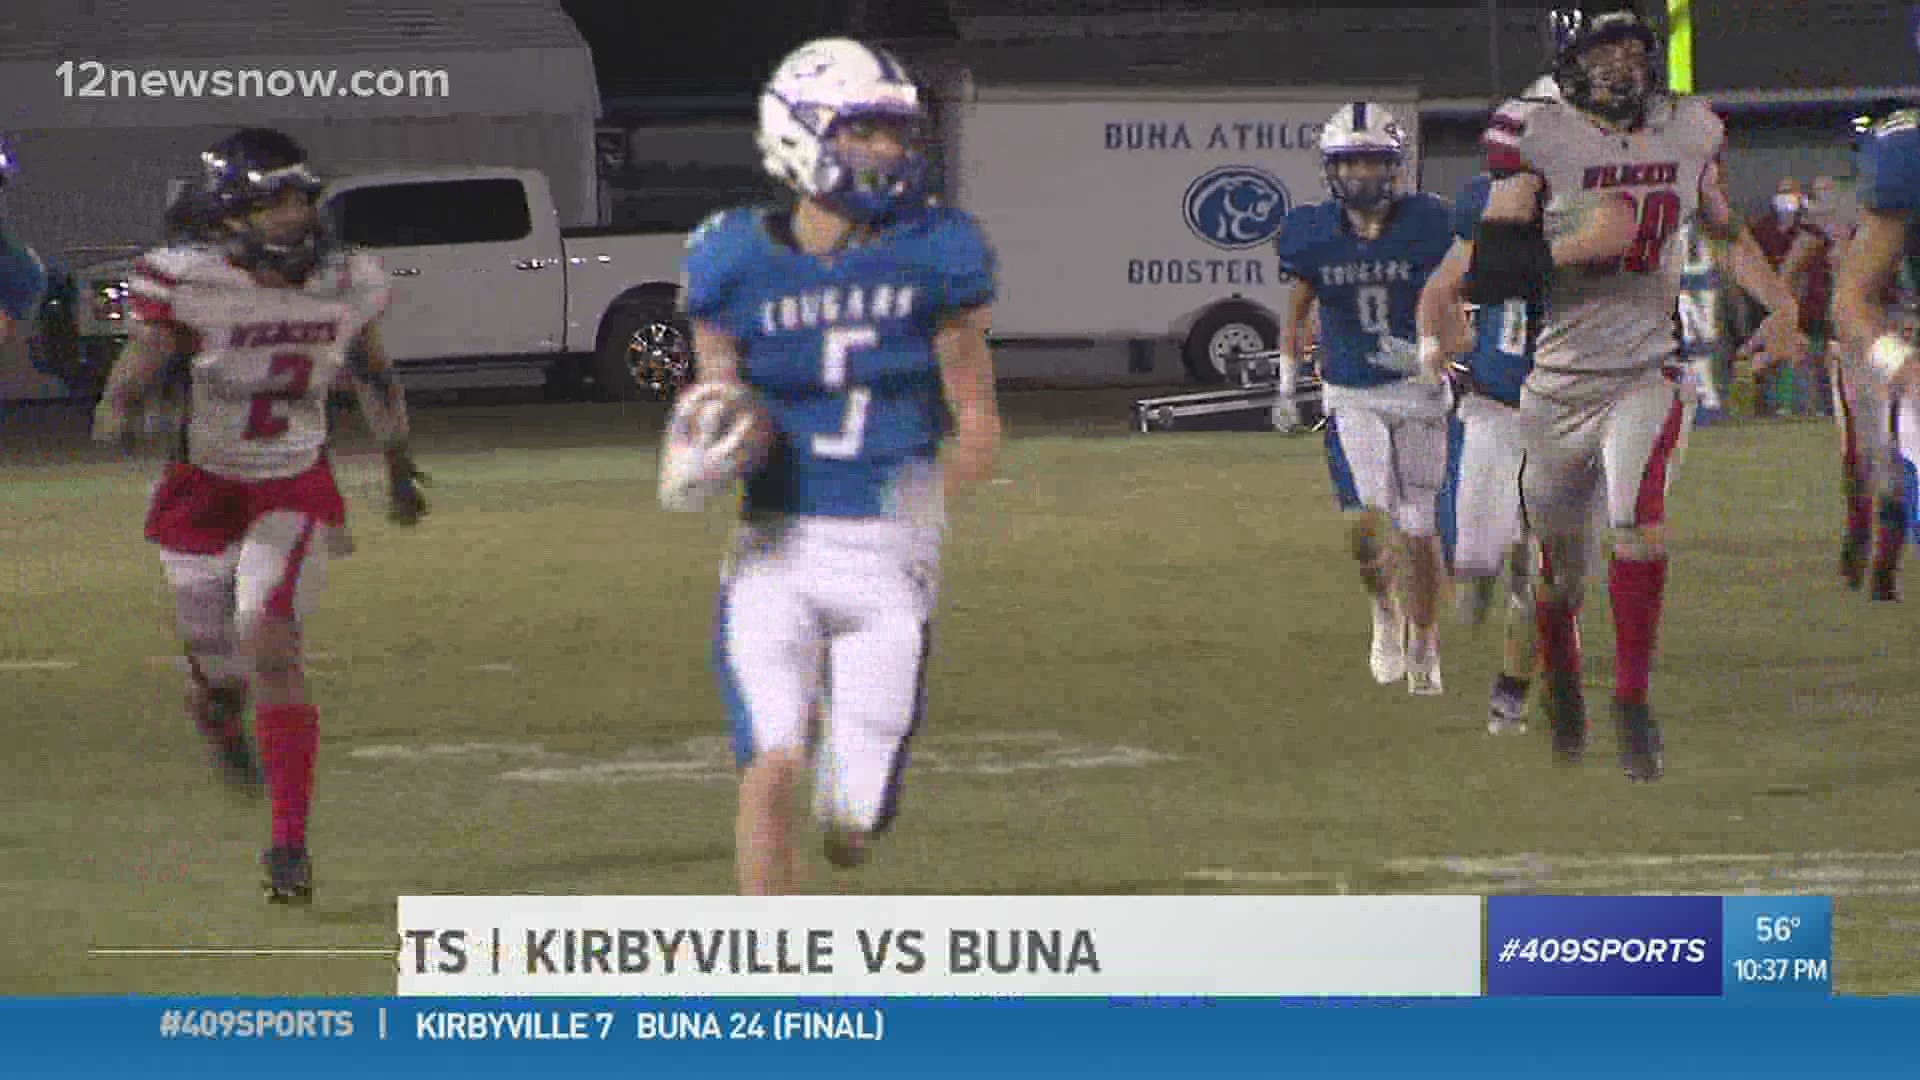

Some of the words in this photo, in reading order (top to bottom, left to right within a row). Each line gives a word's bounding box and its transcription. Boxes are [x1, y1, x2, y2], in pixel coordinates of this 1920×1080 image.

[1104, 122, 1192, 150] BUNA
[1127, 259, 1264, 286] BOOSTER
[241, 353, 314, 441] 2
[811, 323, 880, 461] 5
